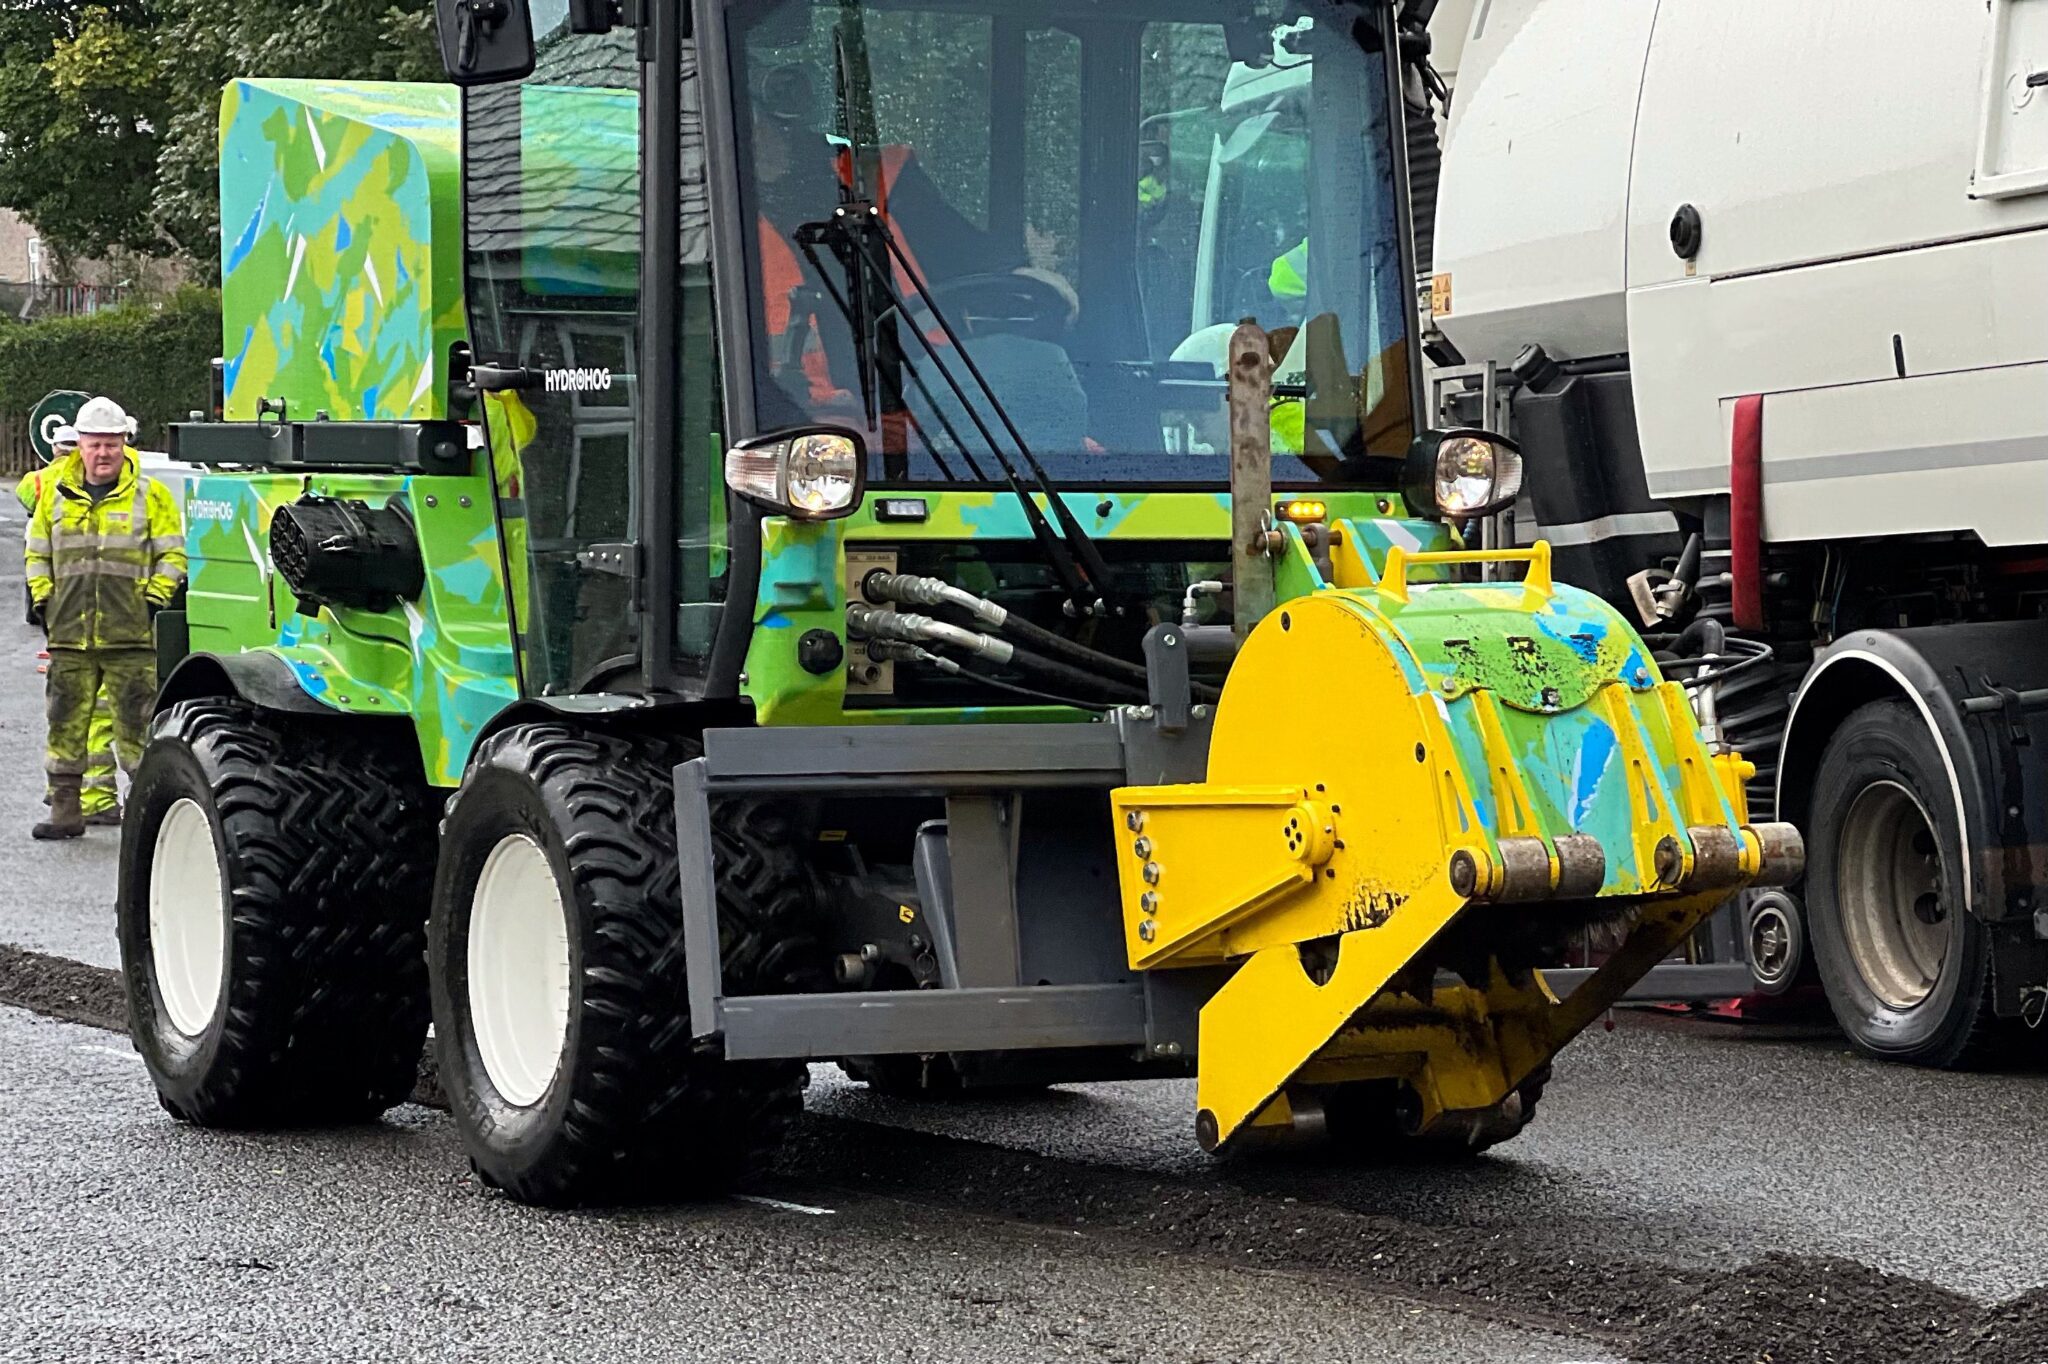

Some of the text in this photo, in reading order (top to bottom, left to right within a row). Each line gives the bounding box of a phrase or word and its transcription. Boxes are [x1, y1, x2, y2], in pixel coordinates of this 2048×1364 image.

[545, 367, 612, 392] HYDROHOG
[40, 413, 67, 445] G
[187, 499, 234, 521] HYDROHOG
